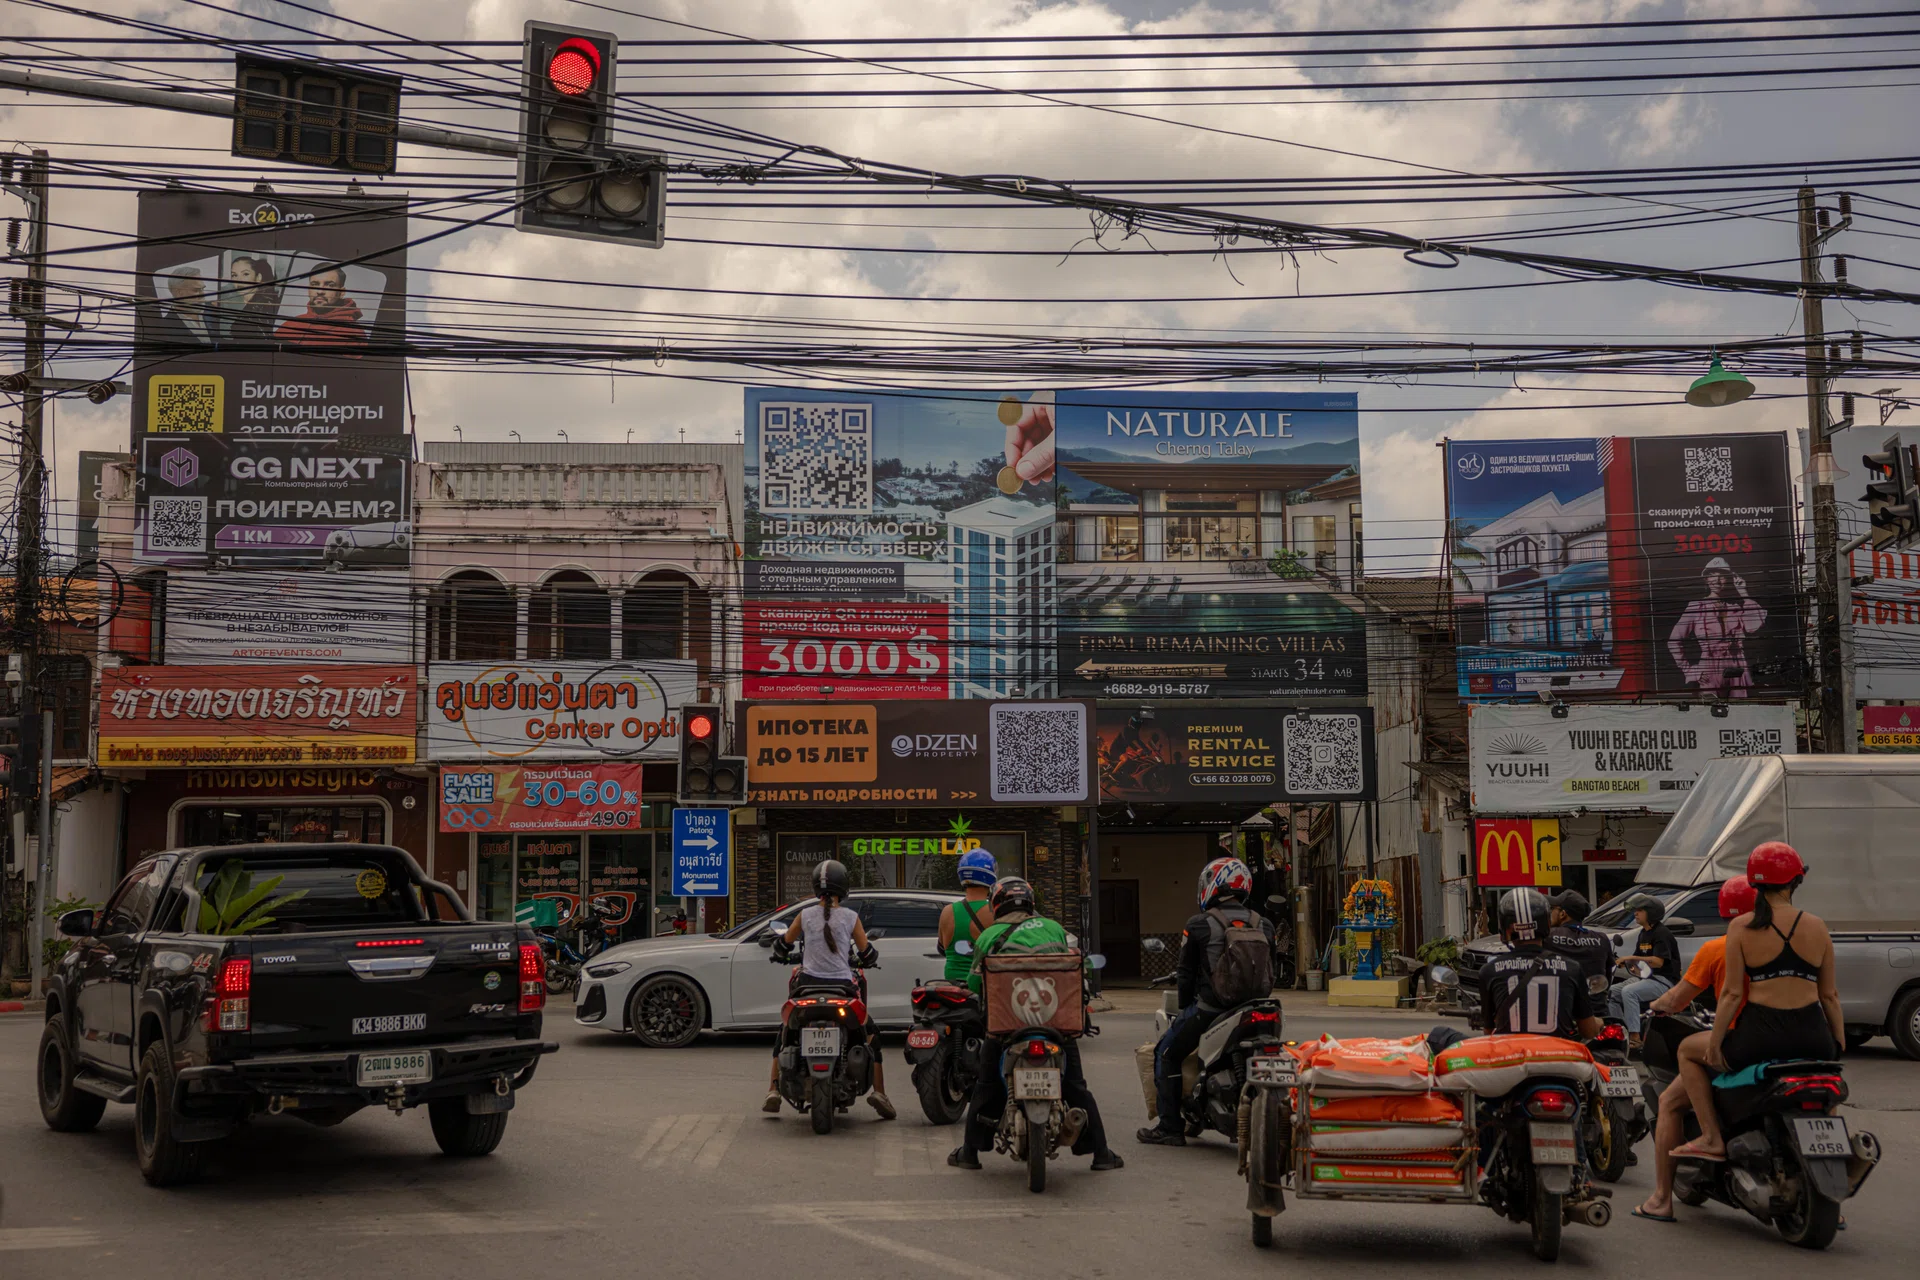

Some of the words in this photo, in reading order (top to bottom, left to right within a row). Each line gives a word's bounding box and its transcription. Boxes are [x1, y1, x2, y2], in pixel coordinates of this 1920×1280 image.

[241, 380, 328, 399] Билеты
[240, 405, 268, 420] на
[273, 405, 384, 423] концерты
[1106, 411, 1293, 438] NATURALE
[1155, 441, 1211, 458] Cherng
[1216, 441, 1255, 459] Talay
[1490, 456, 1508, 465] ОДИН
[1509, 456, 1518, 464] ИЗ
[1518, 455, 1550, 465] ВЕДУЩИХ
[1556, 452, 1595, 462] СТАРЕЙШИХ
[230, 457, 283, 479] GG
[290, 457, 383, 479] NEXT
[1490, 464, 1541, 474] ЗАСТРОЙЩИКОВ
[1541, 464, 1570, 473] ПХУКЕТА
[264, 480, 327, 489] Компьютерный
[329, 480, 348, 488] клуб
[215, 499, 396, 519] ПОИГРАЕМ?
[1648, 506, 1701, 518] сканируй
[1703, 505, 1721, 517] QR
[1733, 506, 1774, 516] получи
[760, 520, 938, 536] НЕДВИЖИМОСТЬ
[1654, 519, 1715, 530] промо-код
[231, 529, 239, 544] 1
[244, 529, 272, 544] KM
[759, 540, 874, 556] ДВИЖЕТСЯ
[880, 540, 947, 556] ВВЕРХ
[1673, 533, 1753, 556] 3000$
[759, 564, 812, 575] Доходная
[814, 565, 895, 575] недвижимость
[768, 575, 820, 583] отельным
[823, 576, 897, 586] управлением
[759, 607, 831, 621] сканируй
[835, 608, 857, 620] QR
[874, 609, 928, 621] получи
[226, 624, 235, 632] В
[759, 621, 840, 633] промо-код
[843, 622, 861, 632] на
[865, 623, 917, 634] скидку
[1079, 636, 1138, 652] FINAL
[1146, 636, 1270, 652] REMAINING
[1277, 636, 1346, 652] VILLAS
[232, 649, 342, 657] ARTOFEVENTS.COM
[760, 629, 940, 683] 3000$
[1250, 667, 1289, 678] STARTS
[1293, 658, 1325, 680] 34
[1334, 667, 1352, 678] MB
[834, 685, 892, 693] недвижимости
[1103, 683, 1210, 695] +6682-919-8787
[1269, 687, 1347, 697] naturalephuket.com
[436, 672, 638, 721] ศูนย์แว่นตา
[525, 717, 615, 740] Center
[757, 719, 869, 735] ИПОТЕКА
[1188, 725, 1244, 733] PREMIUM
[915, 734, 977, 750] DZEN
[1188, 738, 1270, 751] RENTAL
[1568, 730, 1610, 750] YUUHI
[1613, 730, 1658, 750] BEACH
[1661, 729, 1698, 750] CLUB
[1871, 735, 1890, 745] 086
[1893, 735, 1913, 744] 546
[756, 748, 792, 766] ДО
[796, 747, 820, 763] 15
[824, 747, 869, 763] ЛЕТ
[1188, 755, 1276, 767] SERVICE
[1595, 752, 1607, 771] &
[1610, 751, 1674, 772] KARAOKE
[523, 767, 593, 780] กรอบแว่นลด
[1485, 763, 1549, 777] YUUHI
[444, 773, 494, 788] FLASH
[1201, 775, 1218, 784] +66
[1219, 775, 1231, 783] 62
[1232, 775, 1249, 783] 028
[1250, 774, 1272, 783] 0076
[1572, 781, 1610, 792] BANGTAO
[1612, 780, 1640, 791] BEACH
[444, 787, 494, 804] SALE
[748, 789, 808, 801] УЗНАТЬ
[813, 788, 938, 802] ПОДРОБНОСТИ
[685, 811, 717, 826] ป่าตอง
[688, 827, 714, 836] Patong
[480, 840, 510, 858] ศูนย์
[527, 840, 572, 855] แว่นตา
[679, 853, 724, 871] อนุสาวรีย์
[785, 850, 832, 862] CANNABIS
[1537, 863, 1542, 872] 1
[1546, 862, 1560, 872] km
[681, 872, 719, 880] Monument
[470, 942, 511, 951] HILUX
[1552, 935, 1601, 947] SECURITY
[262, 955, 297, 964] TOYOTA
[1778, 969, 1795, 977] NIKE
[353, 1017, 373, 1033] K34
[374, 1015, 401, 1032] 9886
[402, 1013, 425, 1030] BKK
[807, 1046, 833, 1054] 9556
[394, 1055, 425, 1069] 9886
[1606, 1087, 1637, 1096] 5610
[1809, 1143, 1845, 1155] 4958
